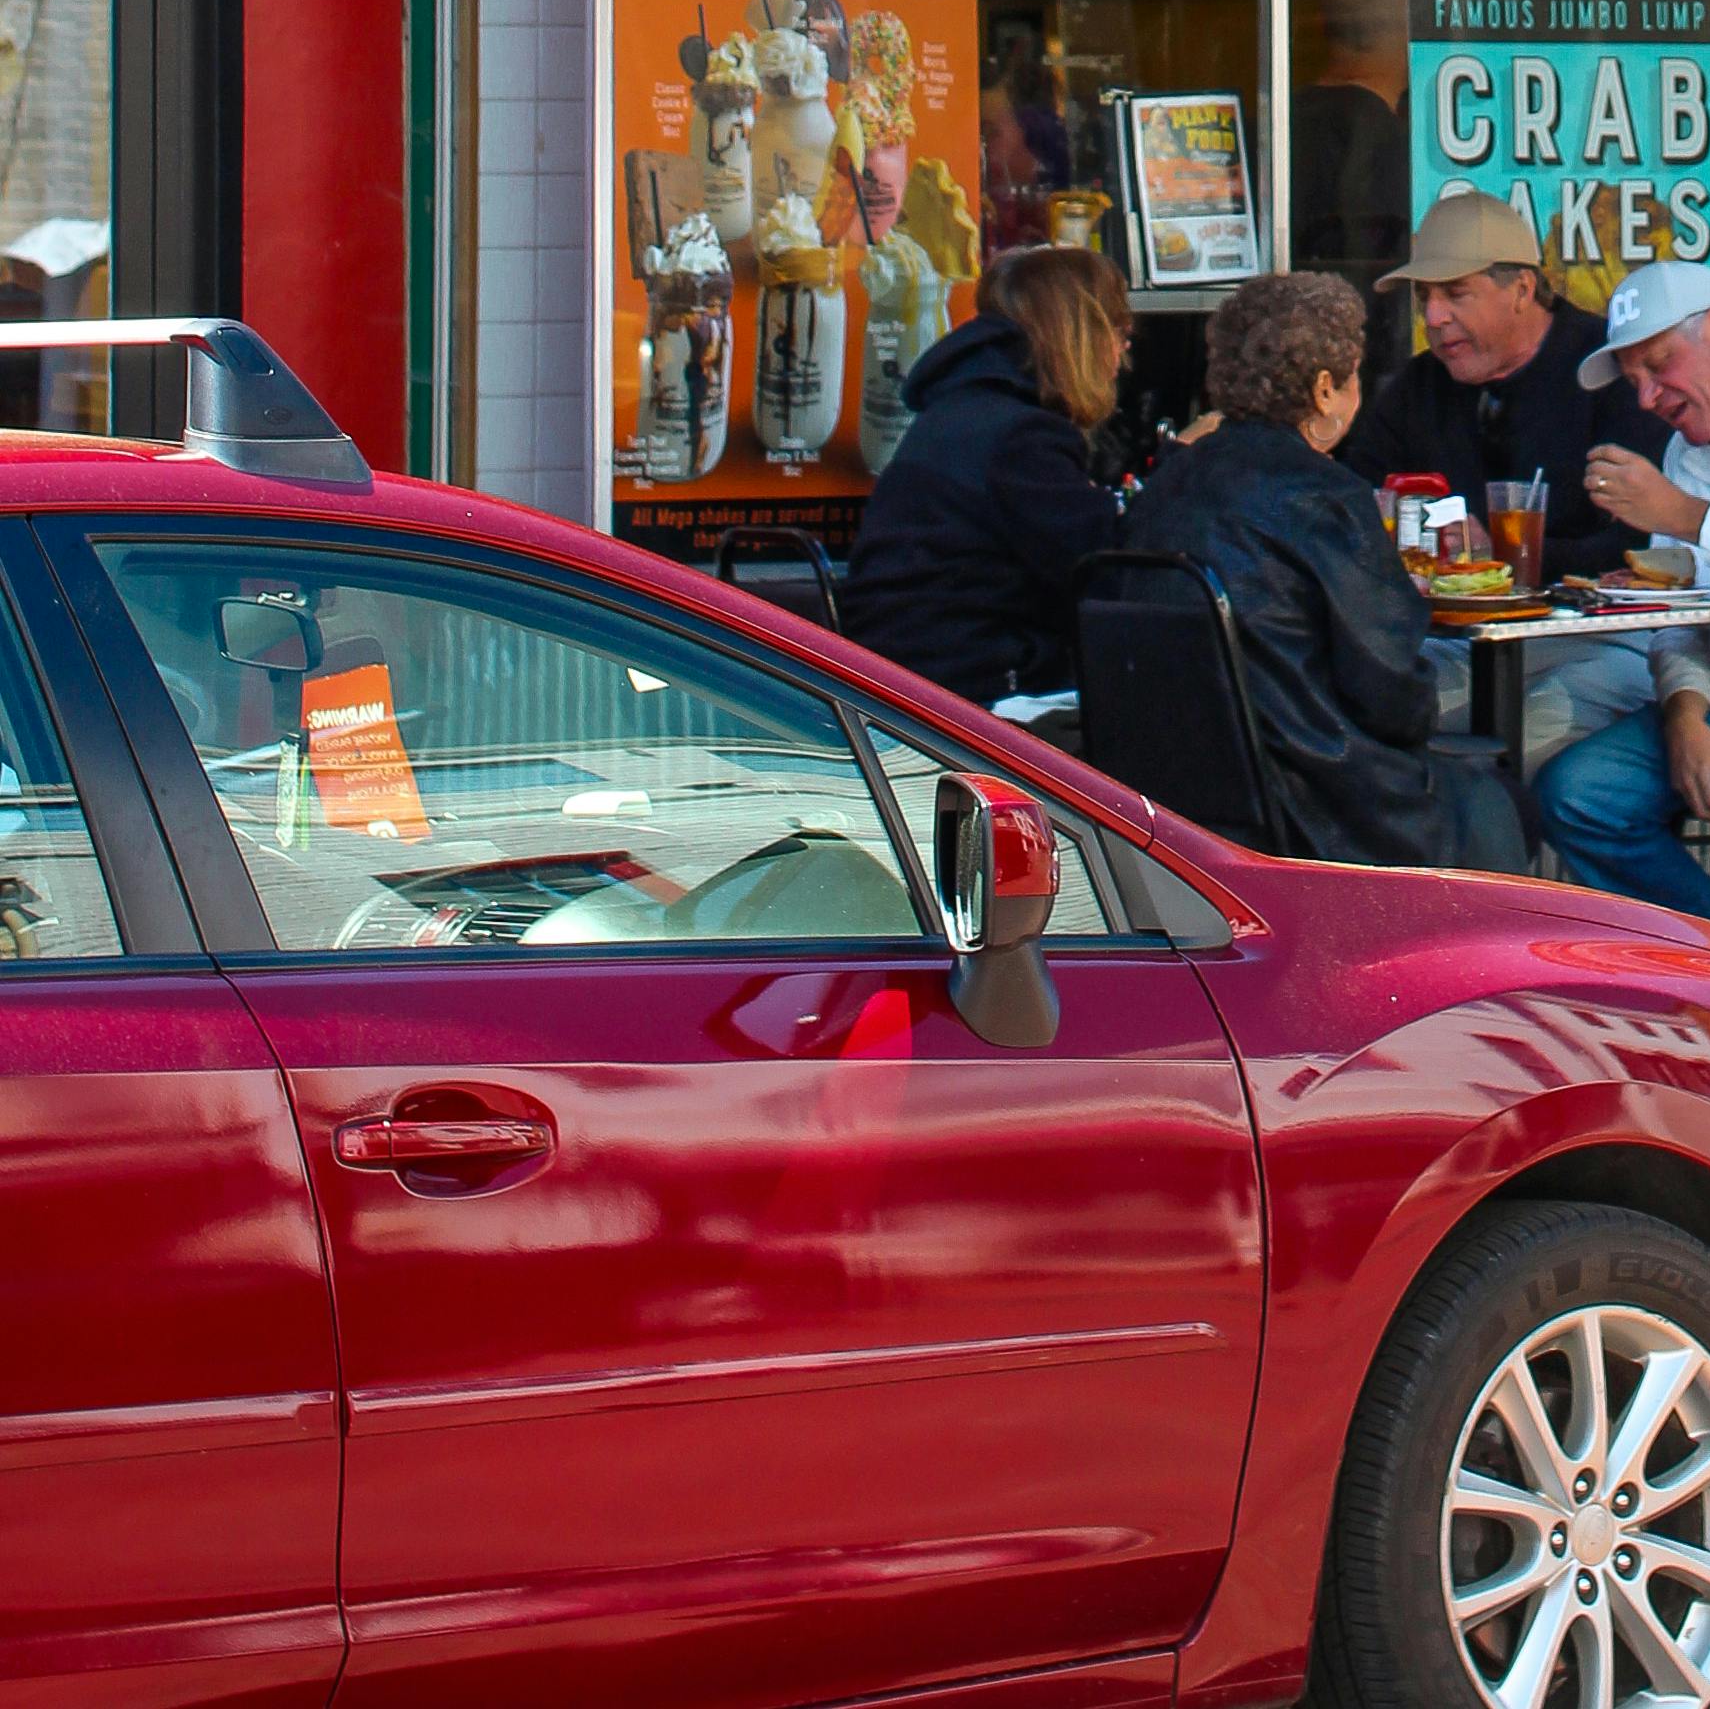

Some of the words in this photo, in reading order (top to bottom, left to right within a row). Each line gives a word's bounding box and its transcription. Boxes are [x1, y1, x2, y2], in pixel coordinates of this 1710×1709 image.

[1549, 0, 1628, 30] JUMBO
[1641, 1, 1706, 31] LUMP
[1436, 55, 1710, 166] CRAB
